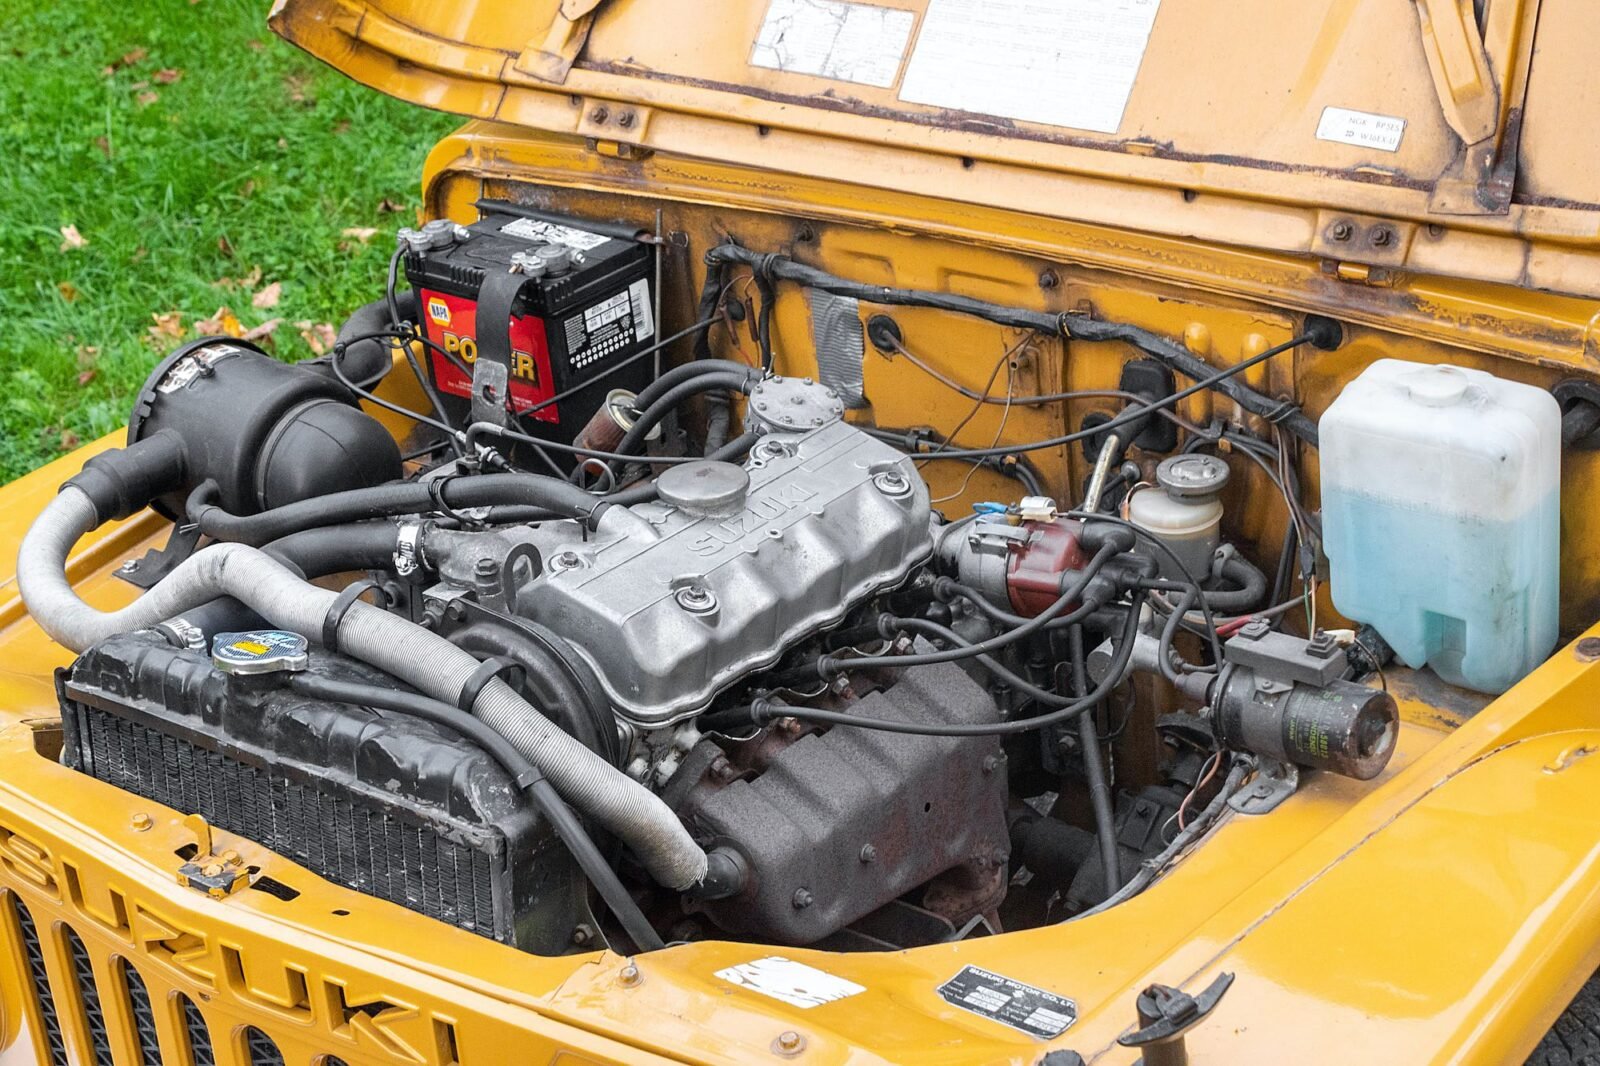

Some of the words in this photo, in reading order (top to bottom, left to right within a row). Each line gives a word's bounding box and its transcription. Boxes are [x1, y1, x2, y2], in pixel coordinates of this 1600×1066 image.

[430, 303, 449, 321] NAPA
[443, 331, 536, 381] POR
[687, 483, 819, 557] SUZUKI
[968, 967, 1005, 984] SUZUKI
[1005, 980, 1041, 997] MOTOR
